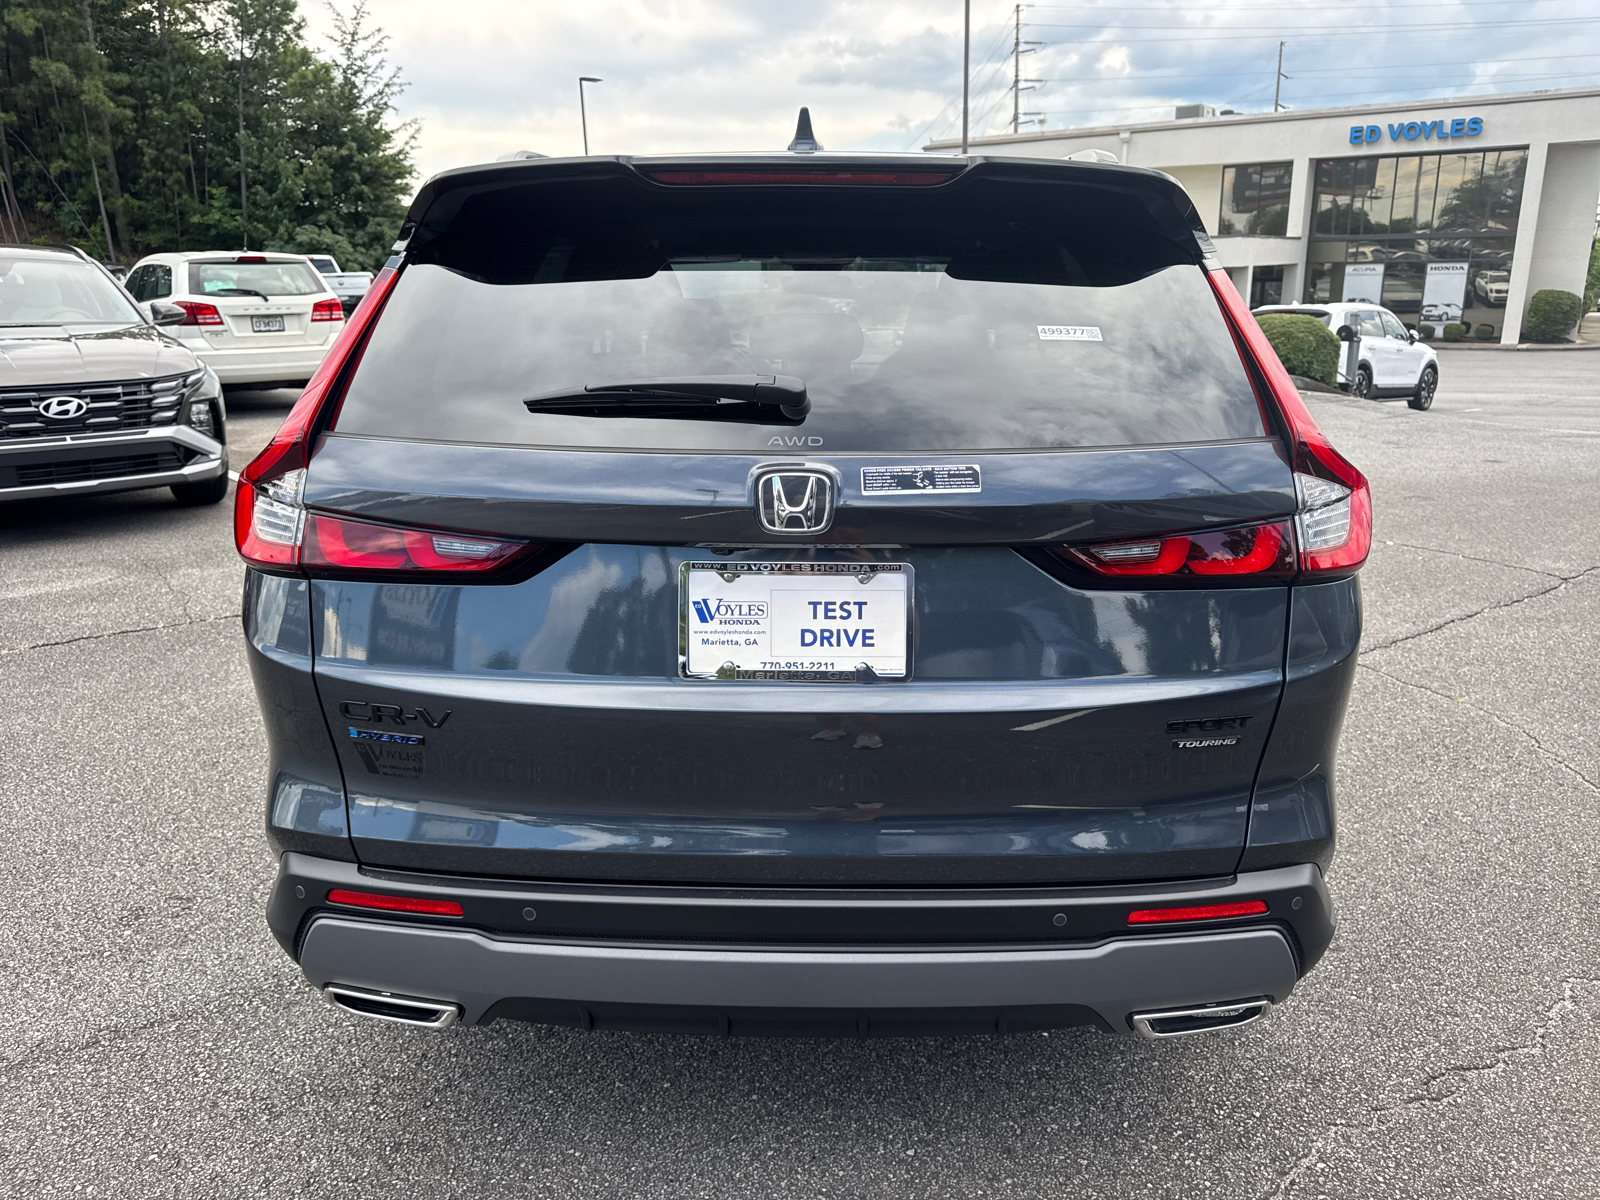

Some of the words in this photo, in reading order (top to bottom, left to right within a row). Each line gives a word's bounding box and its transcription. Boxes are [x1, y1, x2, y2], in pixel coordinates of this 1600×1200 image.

[1349, 125, 1382, 144] ED
[1388, 117, 1483, 141] VOYLES
[1040, 327, 1085, 335] 499377
[767, 436, 824, 446] AWD
[701, 598, 765, 621] VOYLES
[808, 601, 868, 620] TEST
[701, 638, 742, 647] Marietta,
[744, 638, 759, 646] GA
[800, 628, 875, 647] DRIVE
[760, 661, 835, 670] 770-951-2211
[739, 670, 820, 680] Marietta,
[827, 671, 854, 680] GA
[339, 700, 453, 728] CR-V
[1165, 714, 1254, 734] SPORT
[359, 731, 419, 745] HYBRID
[1177, 738, 1238, 748] TOURING
